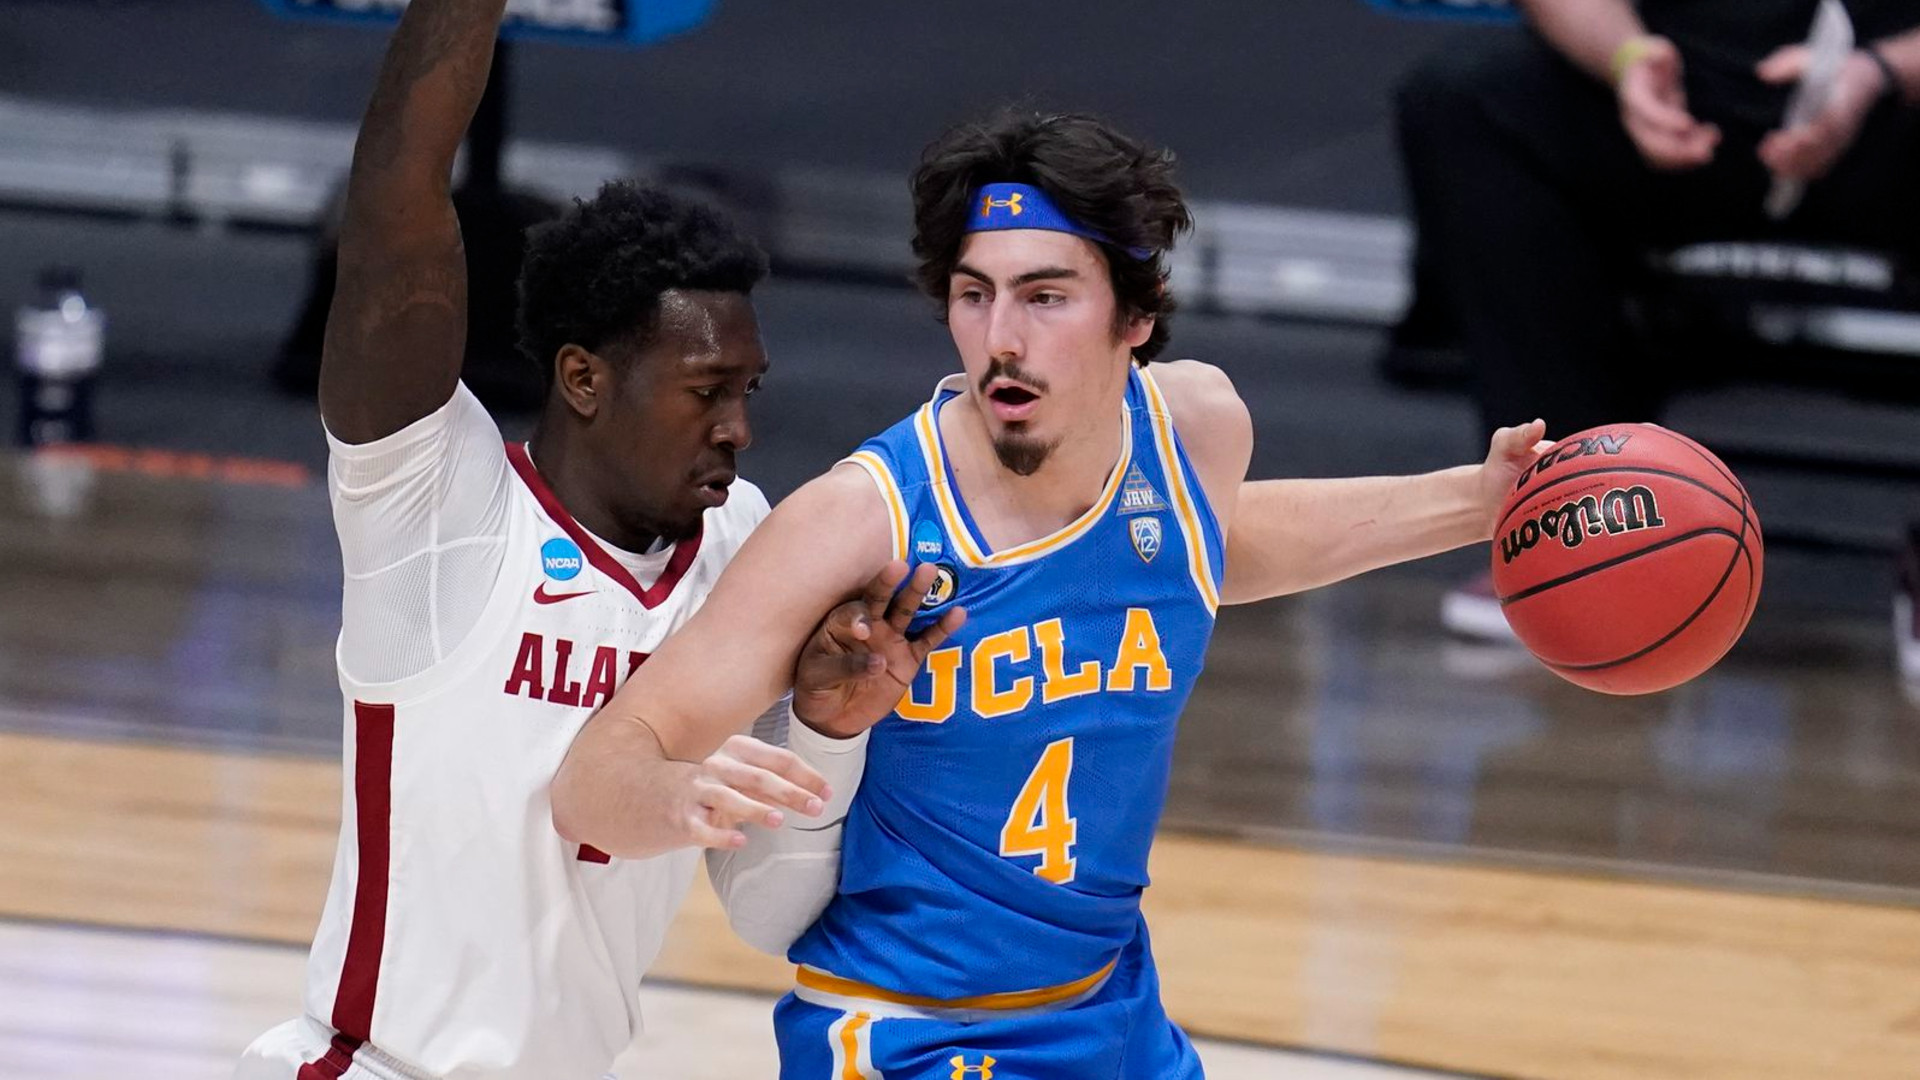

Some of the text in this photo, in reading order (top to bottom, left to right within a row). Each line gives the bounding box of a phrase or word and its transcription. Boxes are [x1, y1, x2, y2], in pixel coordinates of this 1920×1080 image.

[1124, 490, 1154, 507] JRW
[917, 540, 943, 554] NCAA
[1140, 535, 1156, 553] 12
[1500, 484, 1665, 565] Wilson
[545, 556, 580, 570] NCAA
[503, 631, 653, 708] ALA
[893, 607, 1173, 724] UCLA
[999, 736, 1078, 885] 4
